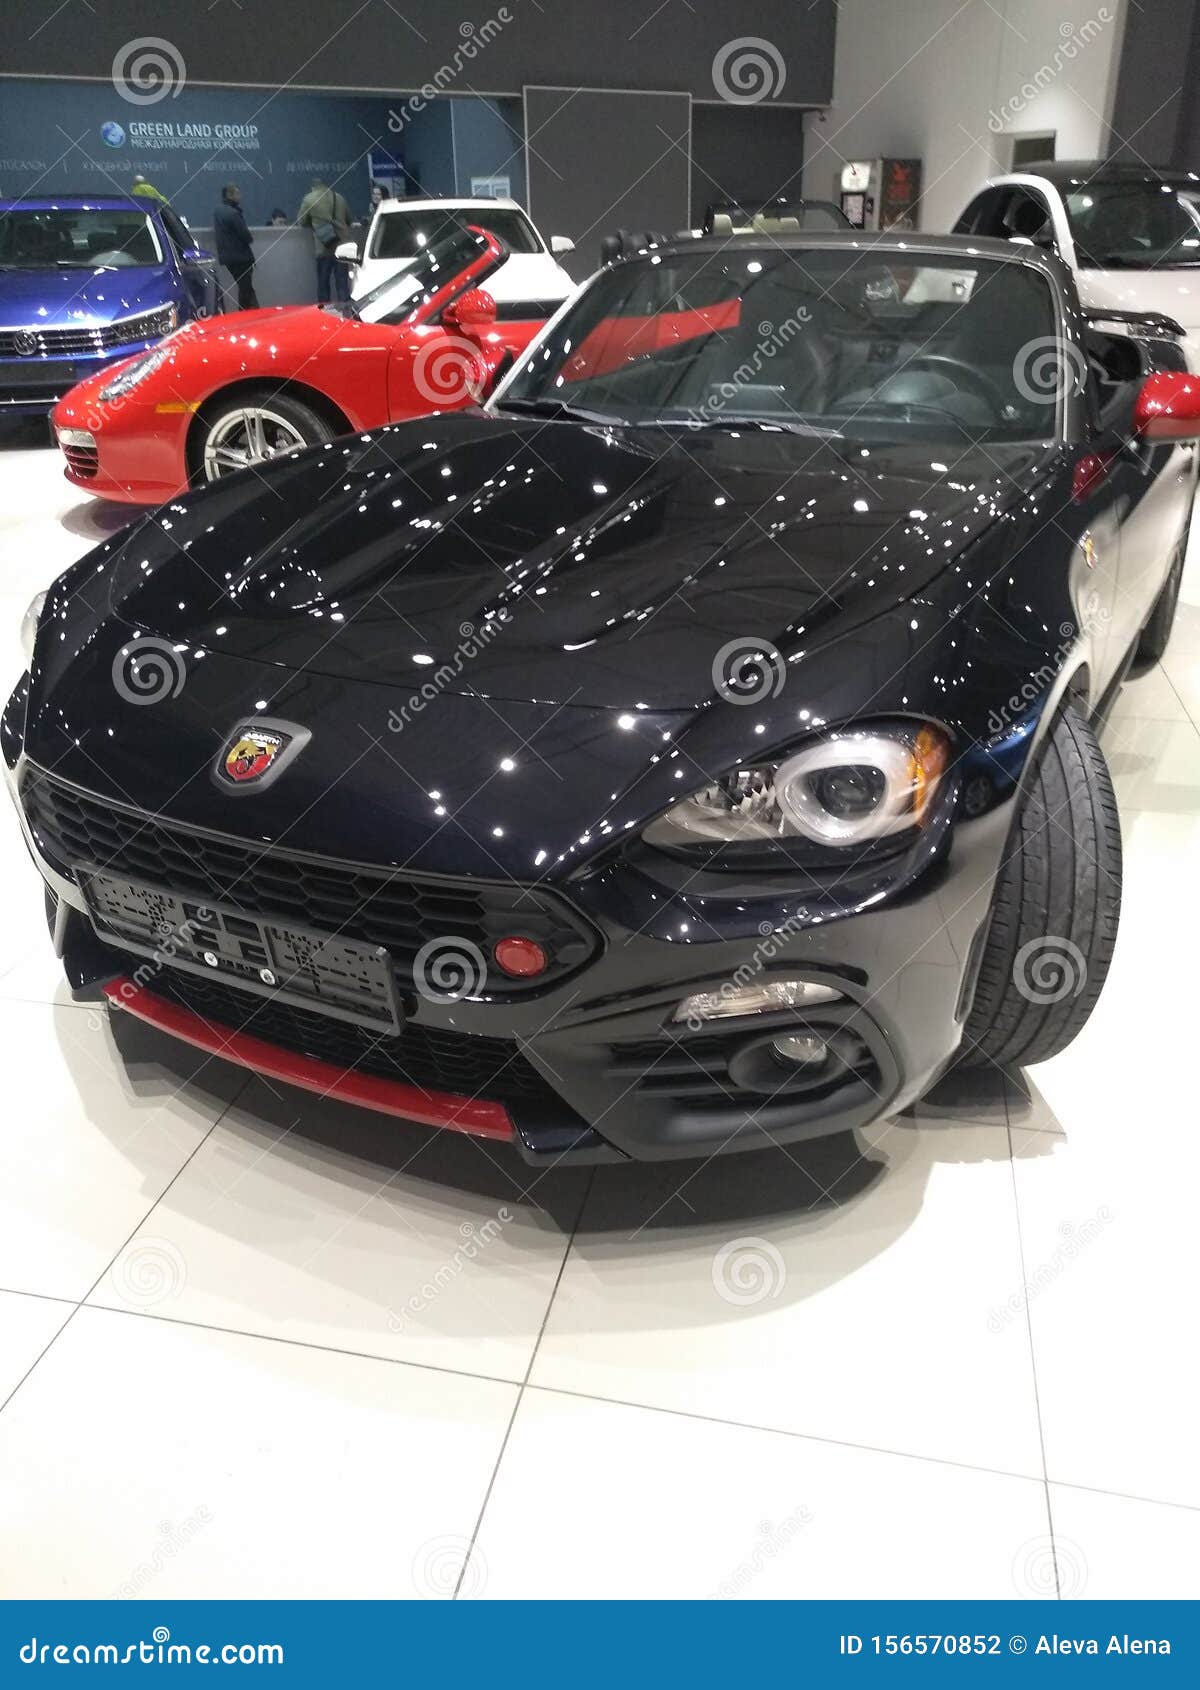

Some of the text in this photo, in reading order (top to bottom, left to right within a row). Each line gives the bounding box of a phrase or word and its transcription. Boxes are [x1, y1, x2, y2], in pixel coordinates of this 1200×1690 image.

[129, 122, 258, 139] GREEN LAND GROUP
